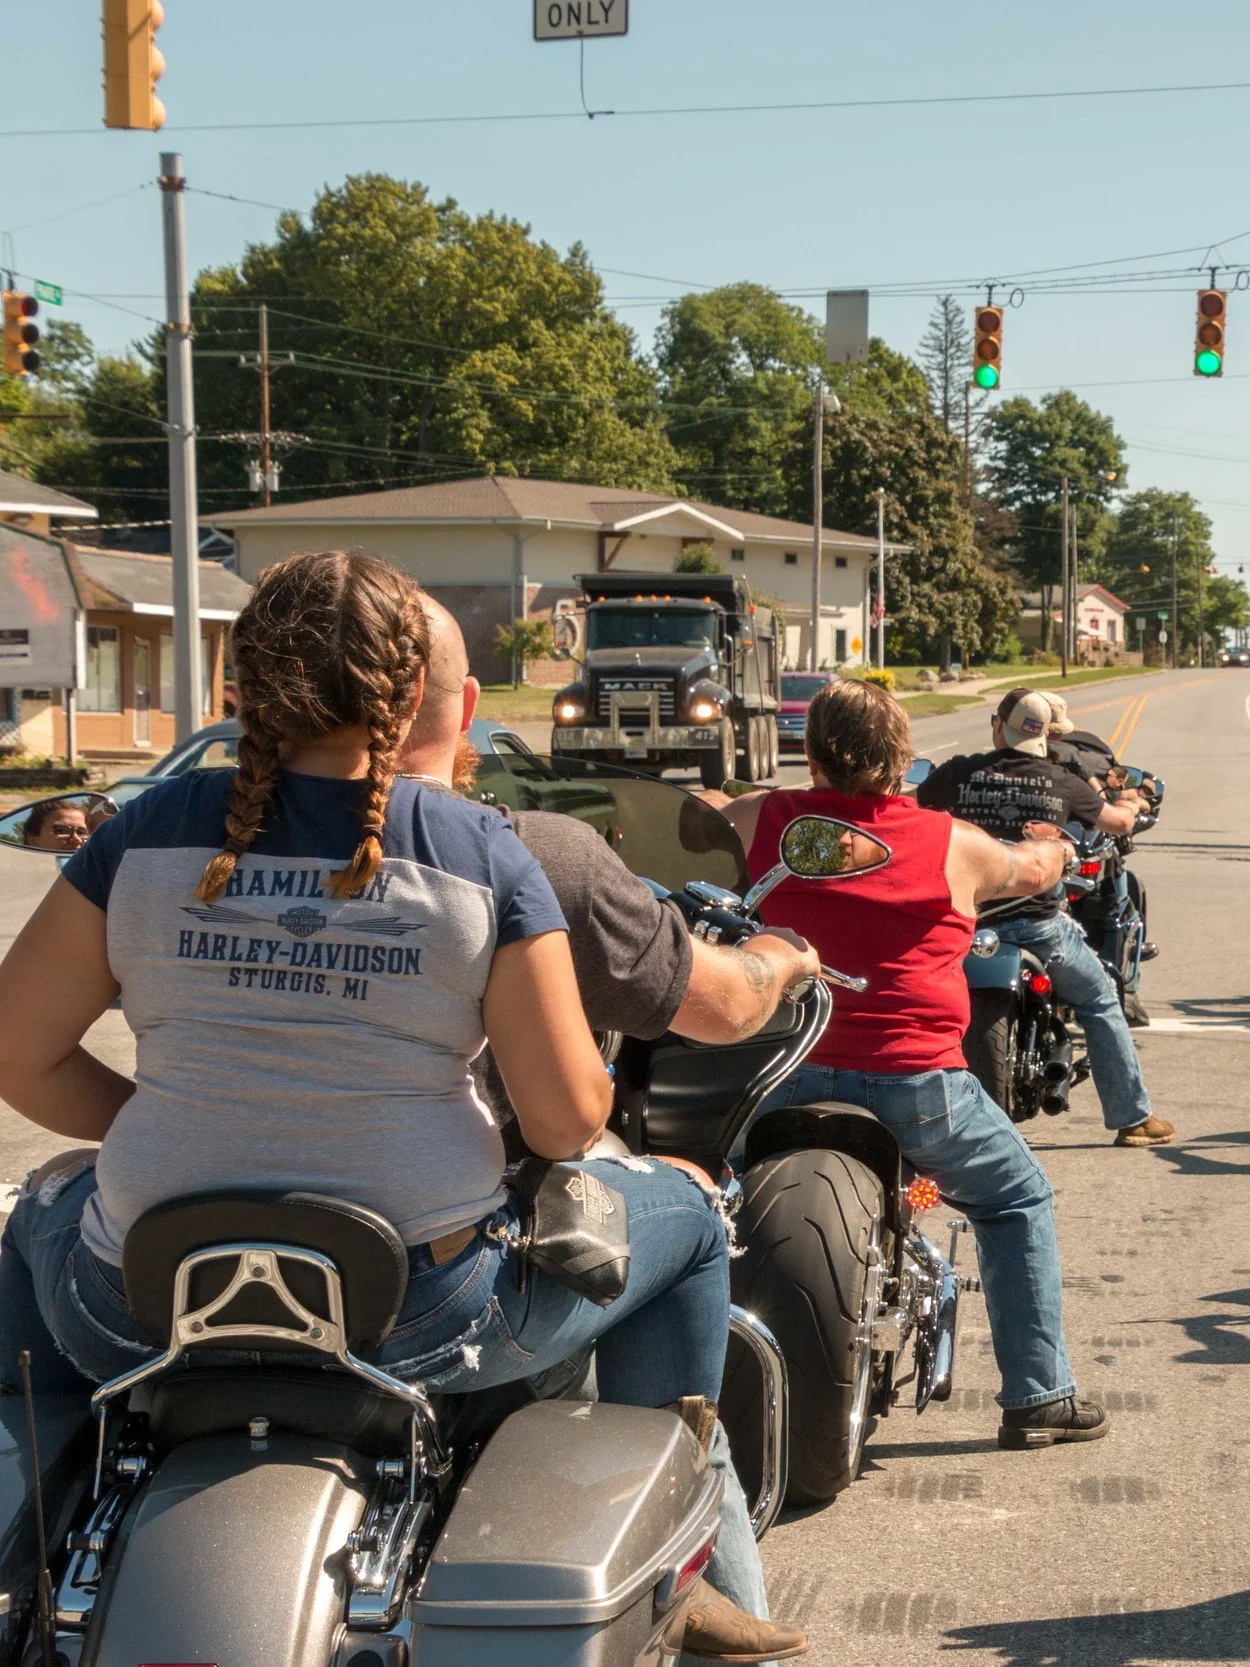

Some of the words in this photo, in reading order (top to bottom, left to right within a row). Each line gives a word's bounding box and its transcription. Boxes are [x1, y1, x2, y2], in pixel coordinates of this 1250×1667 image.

[548, 0, 614, 28] ONLY
[603, 682, 669, 691] MACK
[177, 930, 424, 976] HARLEY-DAVIDSON
[342, 977, 369, 1001] MI
